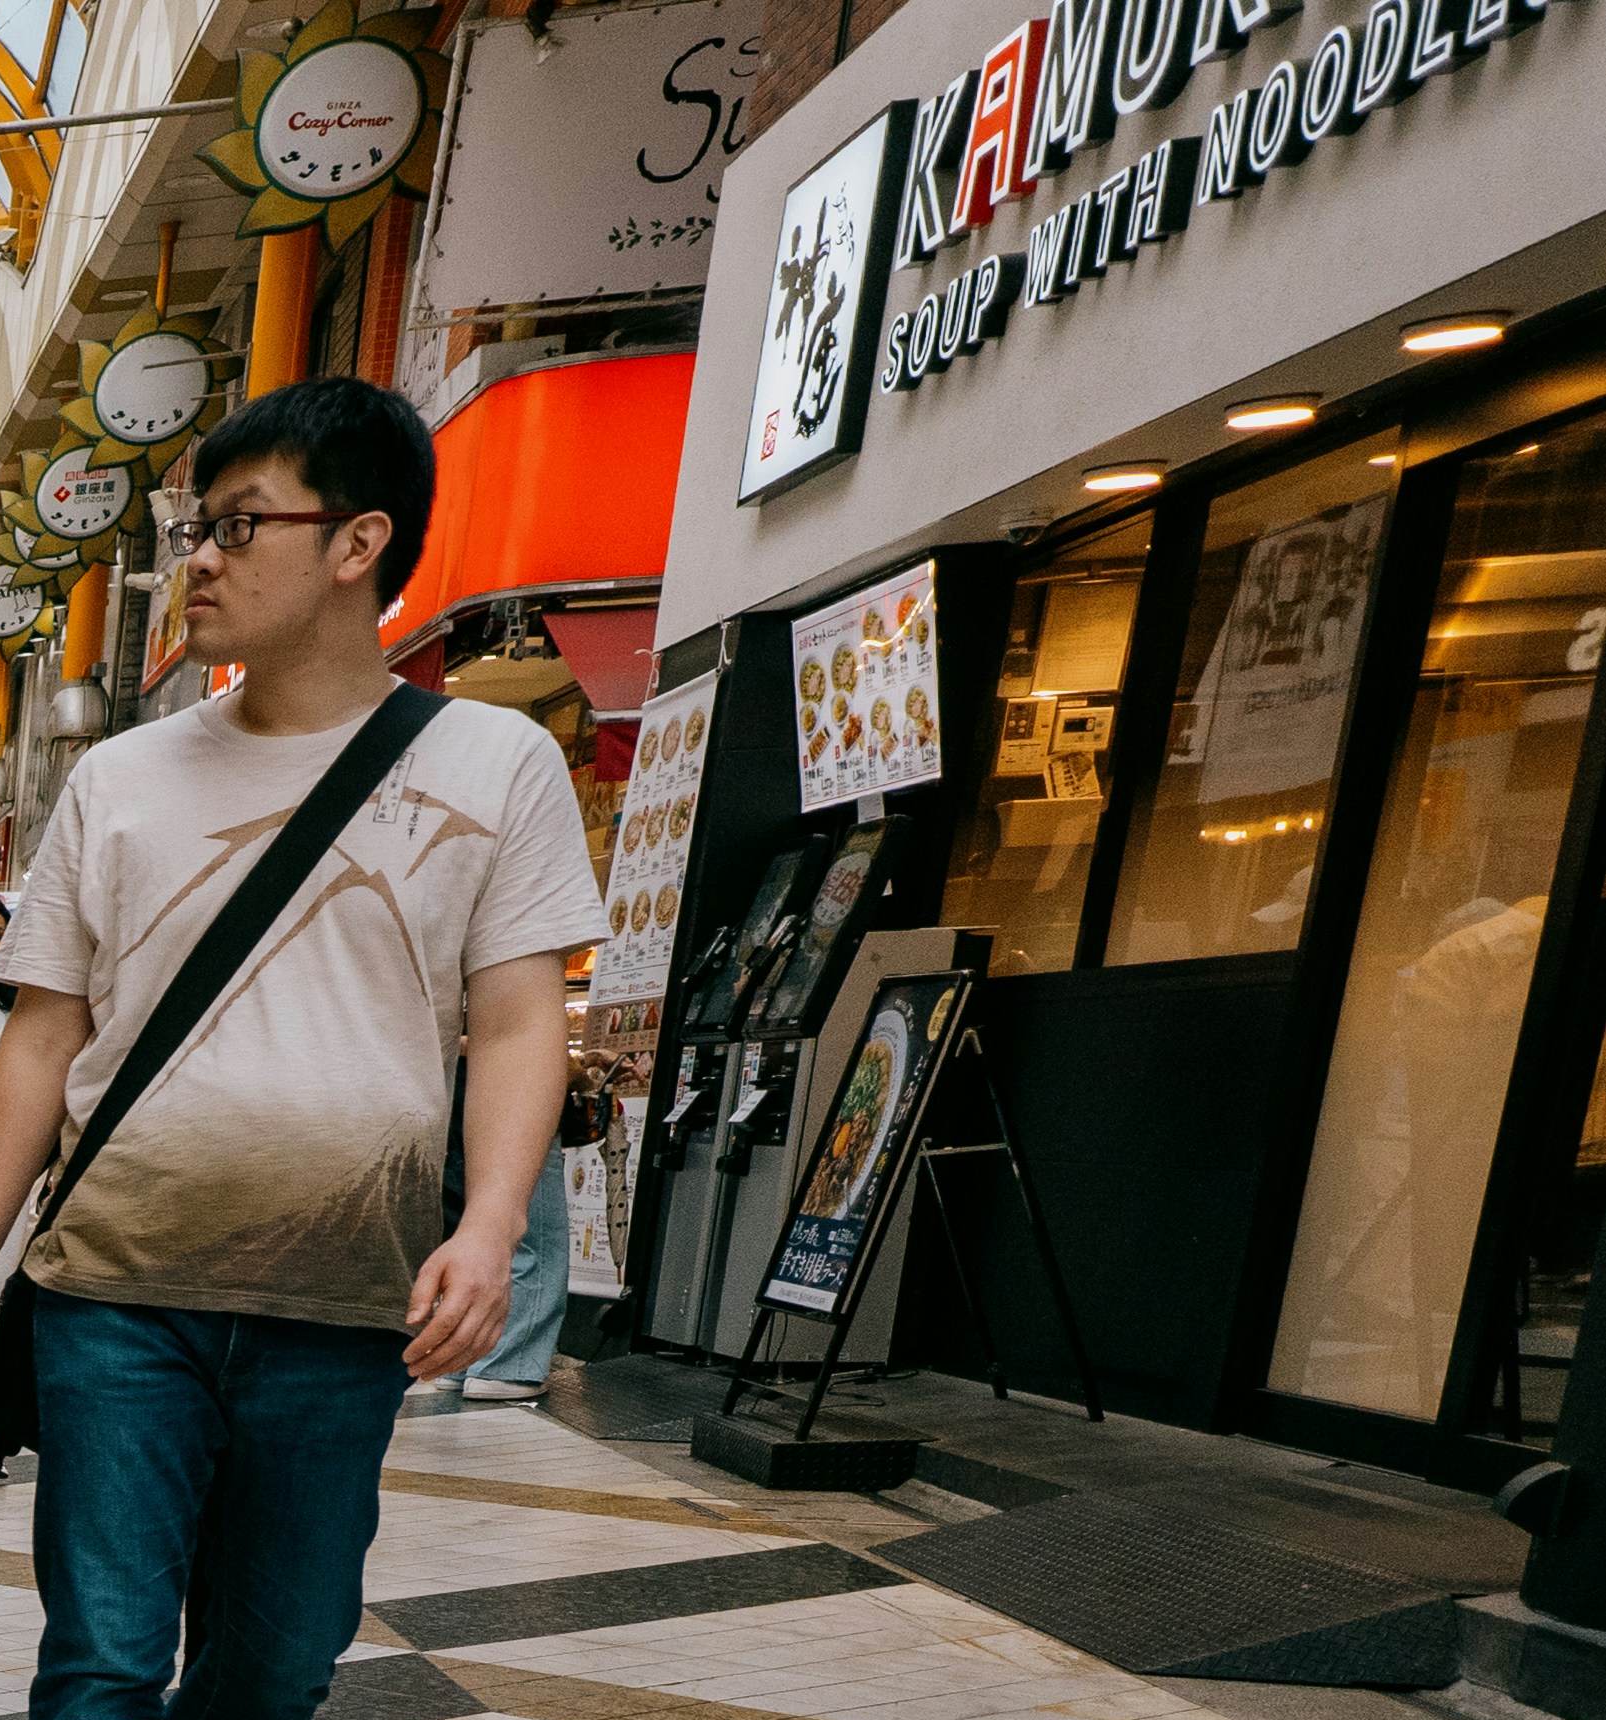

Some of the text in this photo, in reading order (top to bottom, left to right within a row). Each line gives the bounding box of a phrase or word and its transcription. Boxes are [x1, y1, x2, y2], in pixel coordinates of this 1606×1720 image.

[327, 101, 361, 110] GINZA
[288, 111, 394, 137] Cozy Corner
[881, 254, 1003, 396] SOUP
[1024, 139, 1175, 311] WITH
[75, 481, 116, 495] 銀座屋
